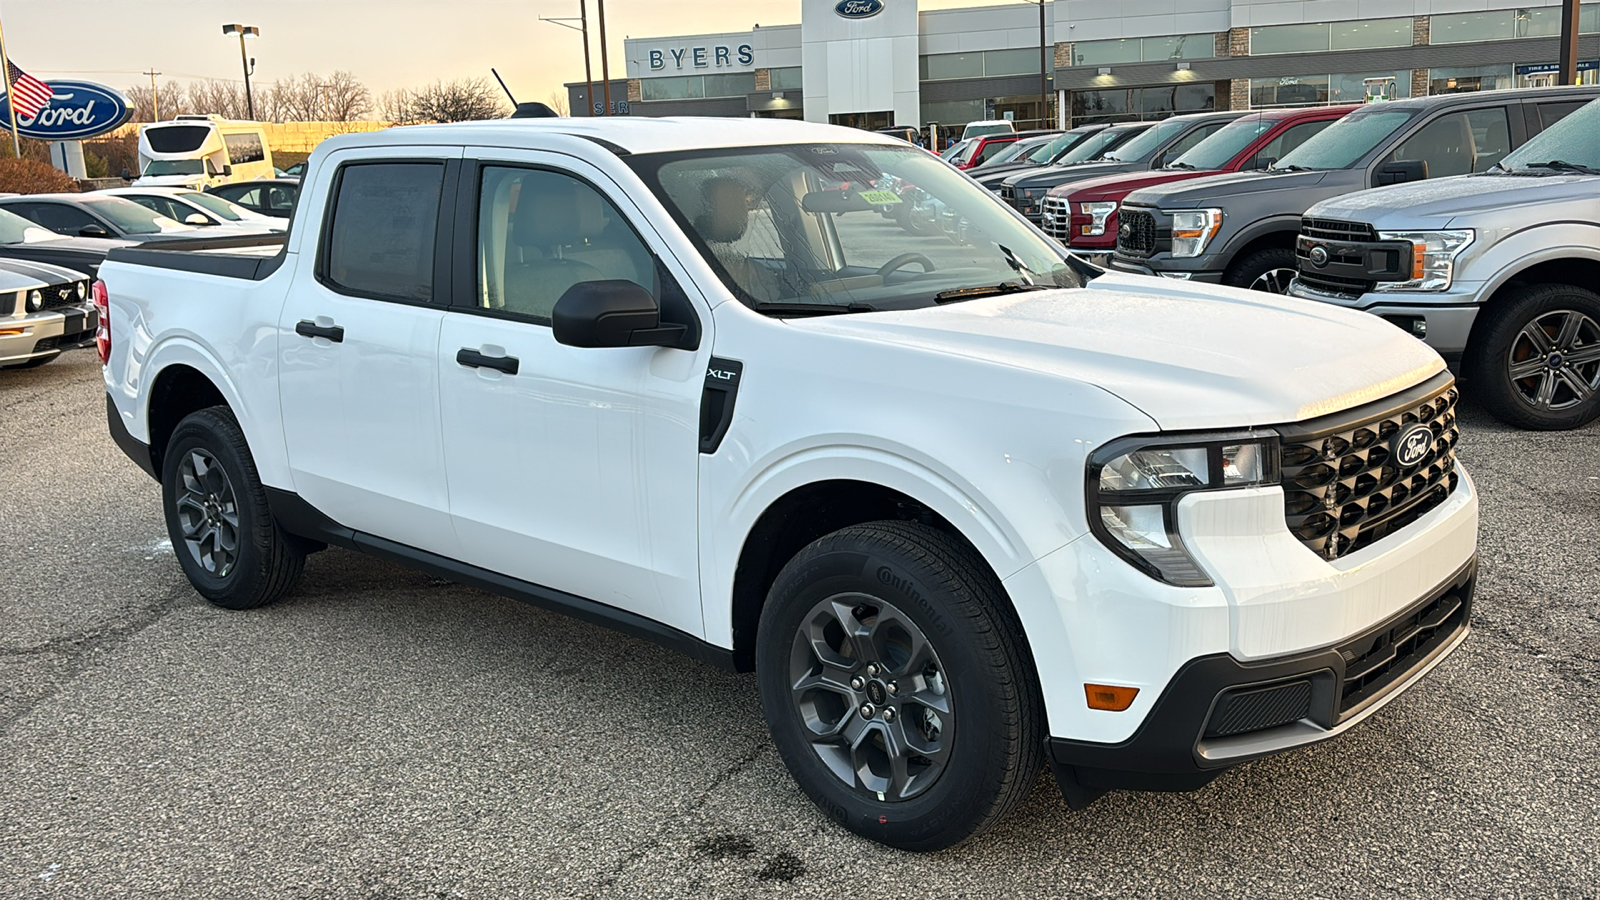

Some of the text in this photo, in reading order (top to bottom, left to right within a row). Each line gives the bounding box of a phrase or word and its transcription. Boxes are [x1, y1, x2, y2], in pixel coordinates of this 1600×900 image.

[845, 1, 872, 13] Ford
[649, 44, 754, 70] BYERS
[1279, 77, 1299, 86] Ford
[706, 368, 736, 380] XLT
[1404, 432, 1428, 462] Ford
[876, 565, 954, 638] Continental
